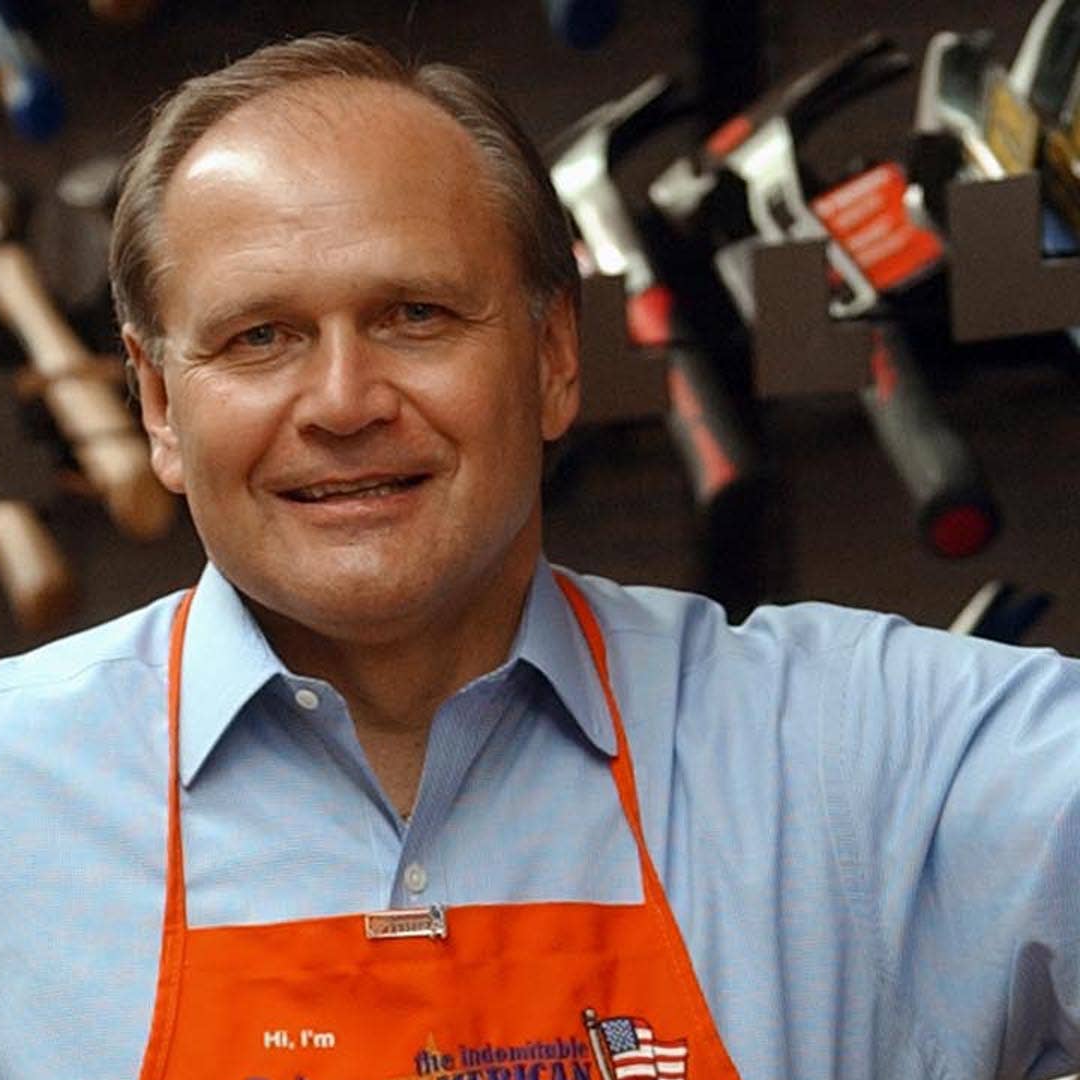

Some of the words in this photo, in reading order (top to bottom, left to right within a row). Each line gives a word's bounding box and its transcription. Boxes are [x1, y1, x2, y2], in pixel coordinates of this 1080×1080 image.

[263, 1029, 295, 1050] Hi,
[301, 1028, 335, 1048] I'm
[414, 1049, 455, 1075] the
[460, 1037, 586, 1067] indomitable
